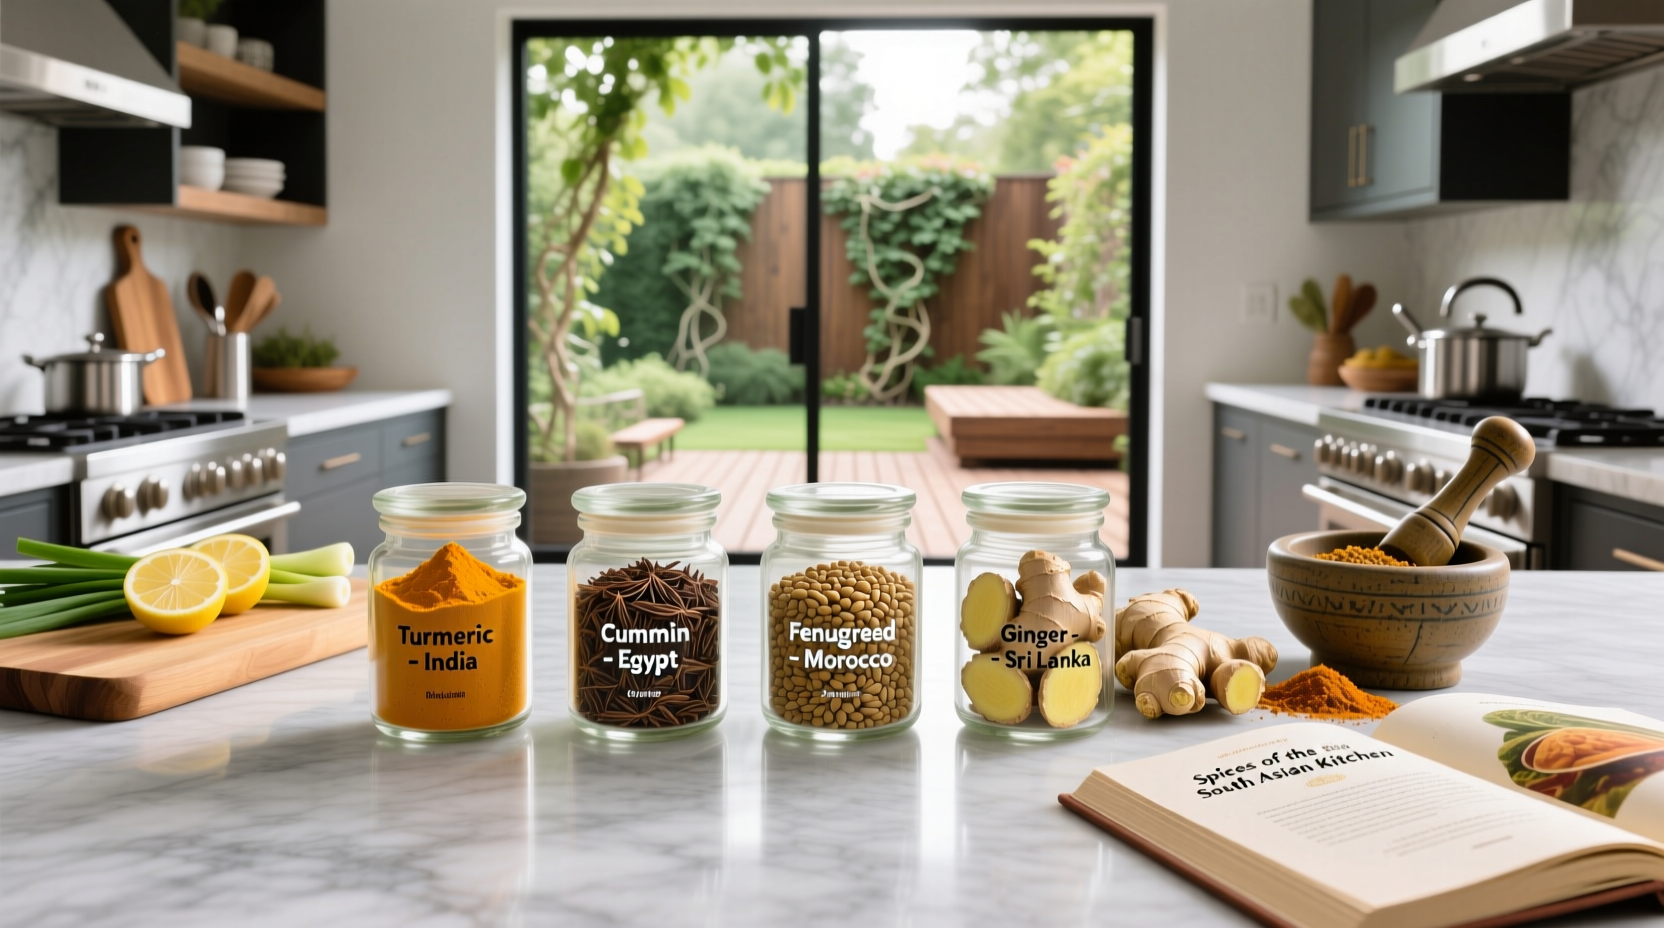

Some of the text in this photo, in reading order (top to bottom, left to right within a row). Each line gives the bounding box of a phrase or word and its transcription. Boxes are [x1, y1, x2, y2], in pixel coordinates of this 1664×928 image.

[398, 624, 494, 646] Turmeric
[601, 622, 690, 644] Cummin
[789, 620, 896, 649] Fenugreed
[1001, 623, 1068, 648] Ginger
[425, 651, 478, 671] India
[618, 649, 679, 676] Egypt
[804, 648, 893, 669] Morocco
[1005, 651, 1032, 669] Sri
[1037, 649, 1091, 670] Lanka
[1193, 762, 1257, 786] Spices
[1261, 752, 1281, 767] of
[1285, 748, 1317, 760] the
[1196, 778, 1255, 799] South
[1260, 763, 1314, 784] Asian
[1315, 750, 1394, 769] Kitchen
